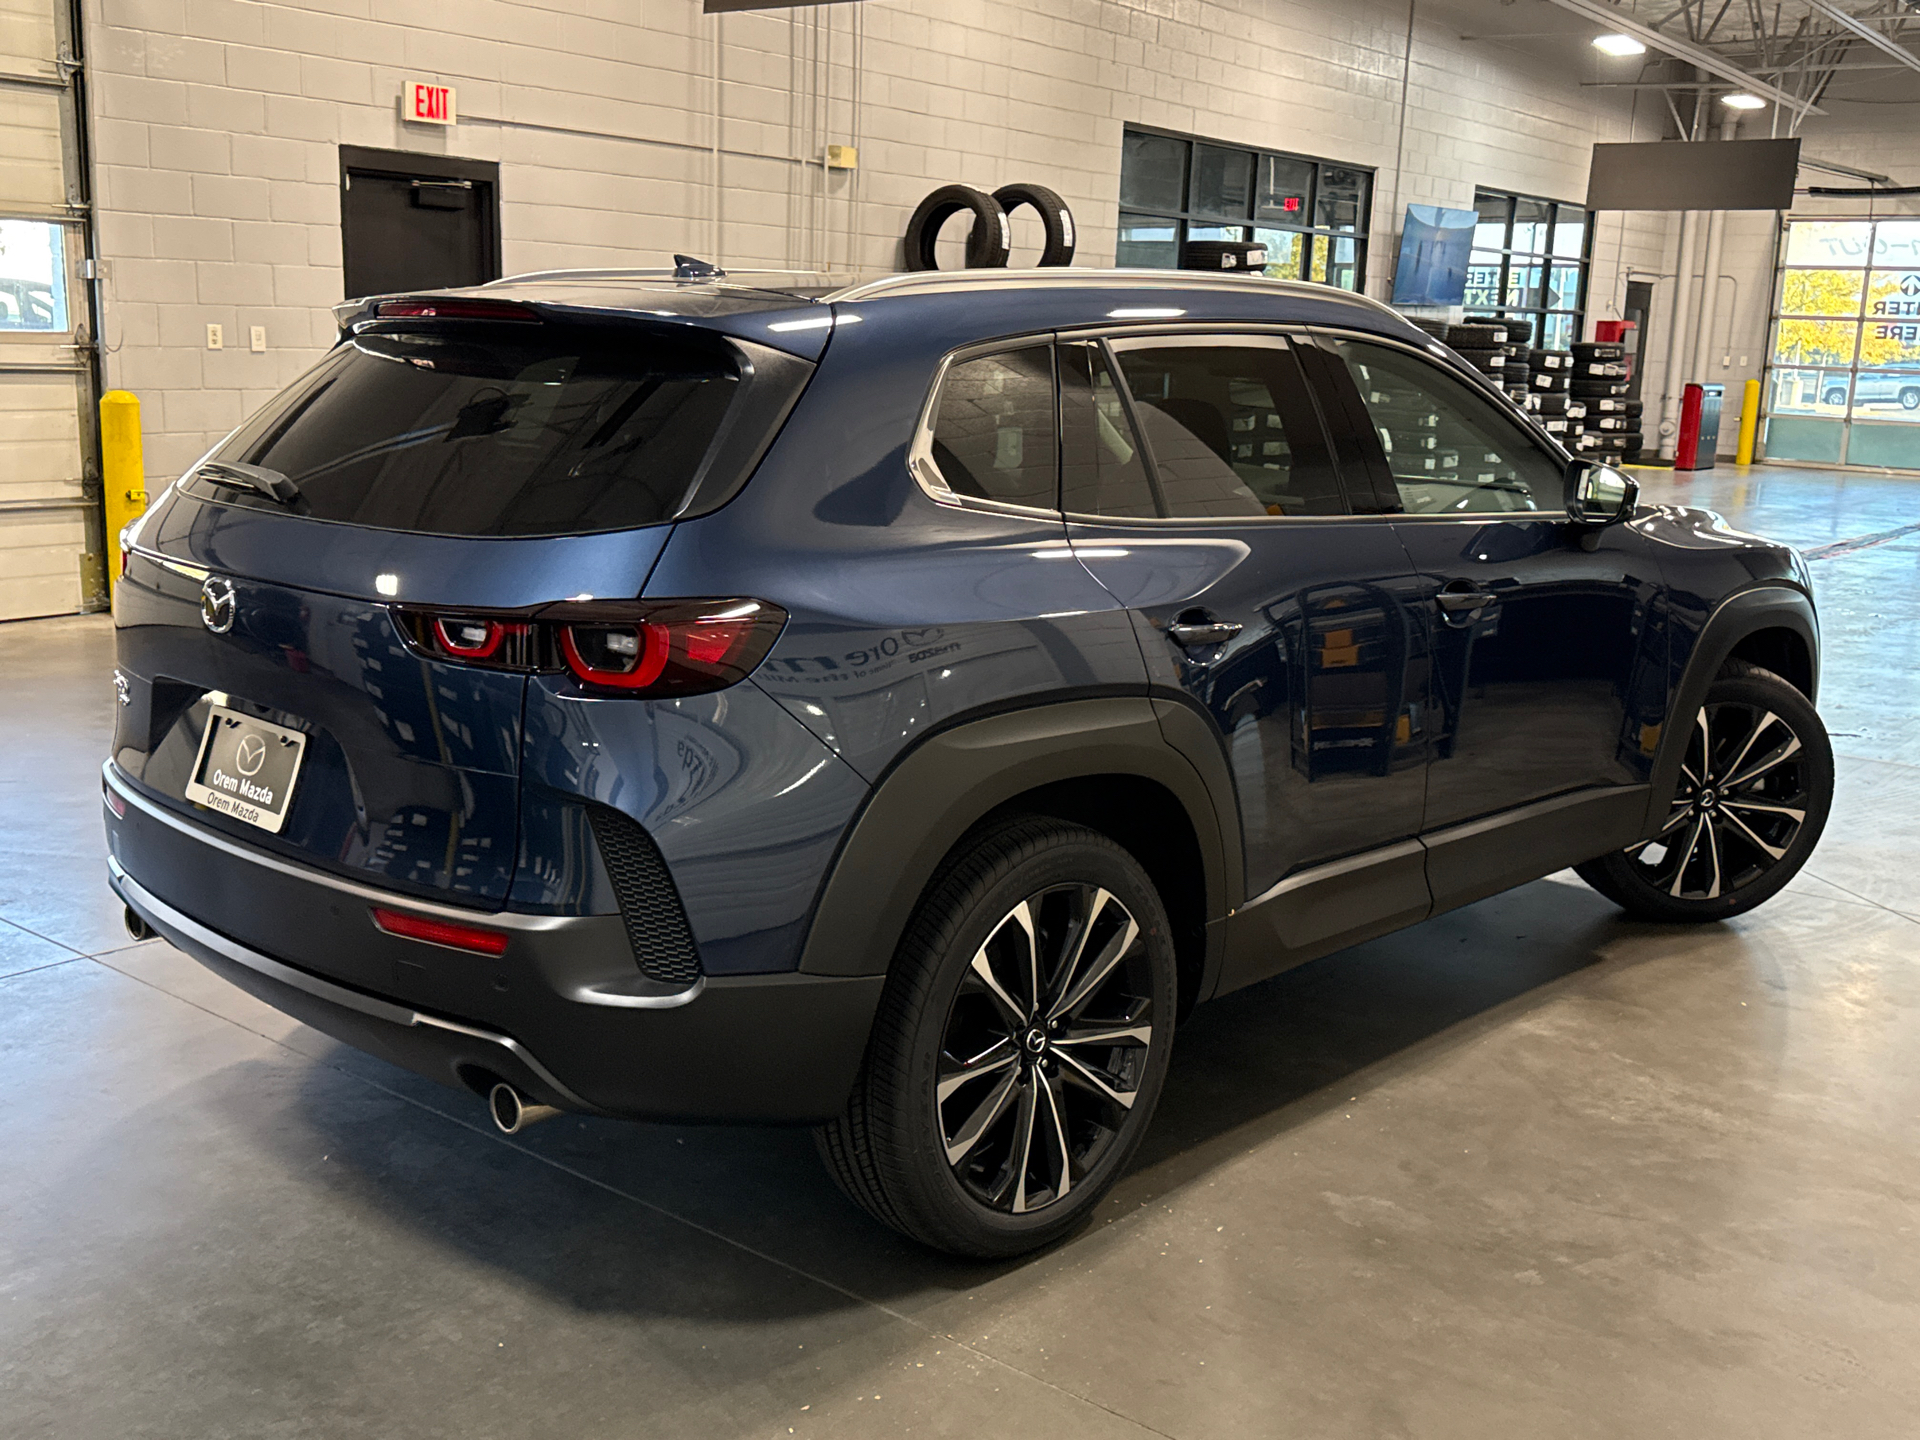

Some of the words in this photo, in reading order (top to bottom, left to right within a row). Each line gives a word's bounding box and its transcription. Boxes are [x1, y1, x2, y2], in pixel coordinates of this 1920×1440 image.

[415, 84, 449, 120] EXIT
[1284, 197, 1299, 211] EXIT
[213, 769, 238, 792] Orem
[240, 779, 273, 805] Mazda
[207, 792, 230, 811] Orem
[231, 801, 259, 822] Mazda
